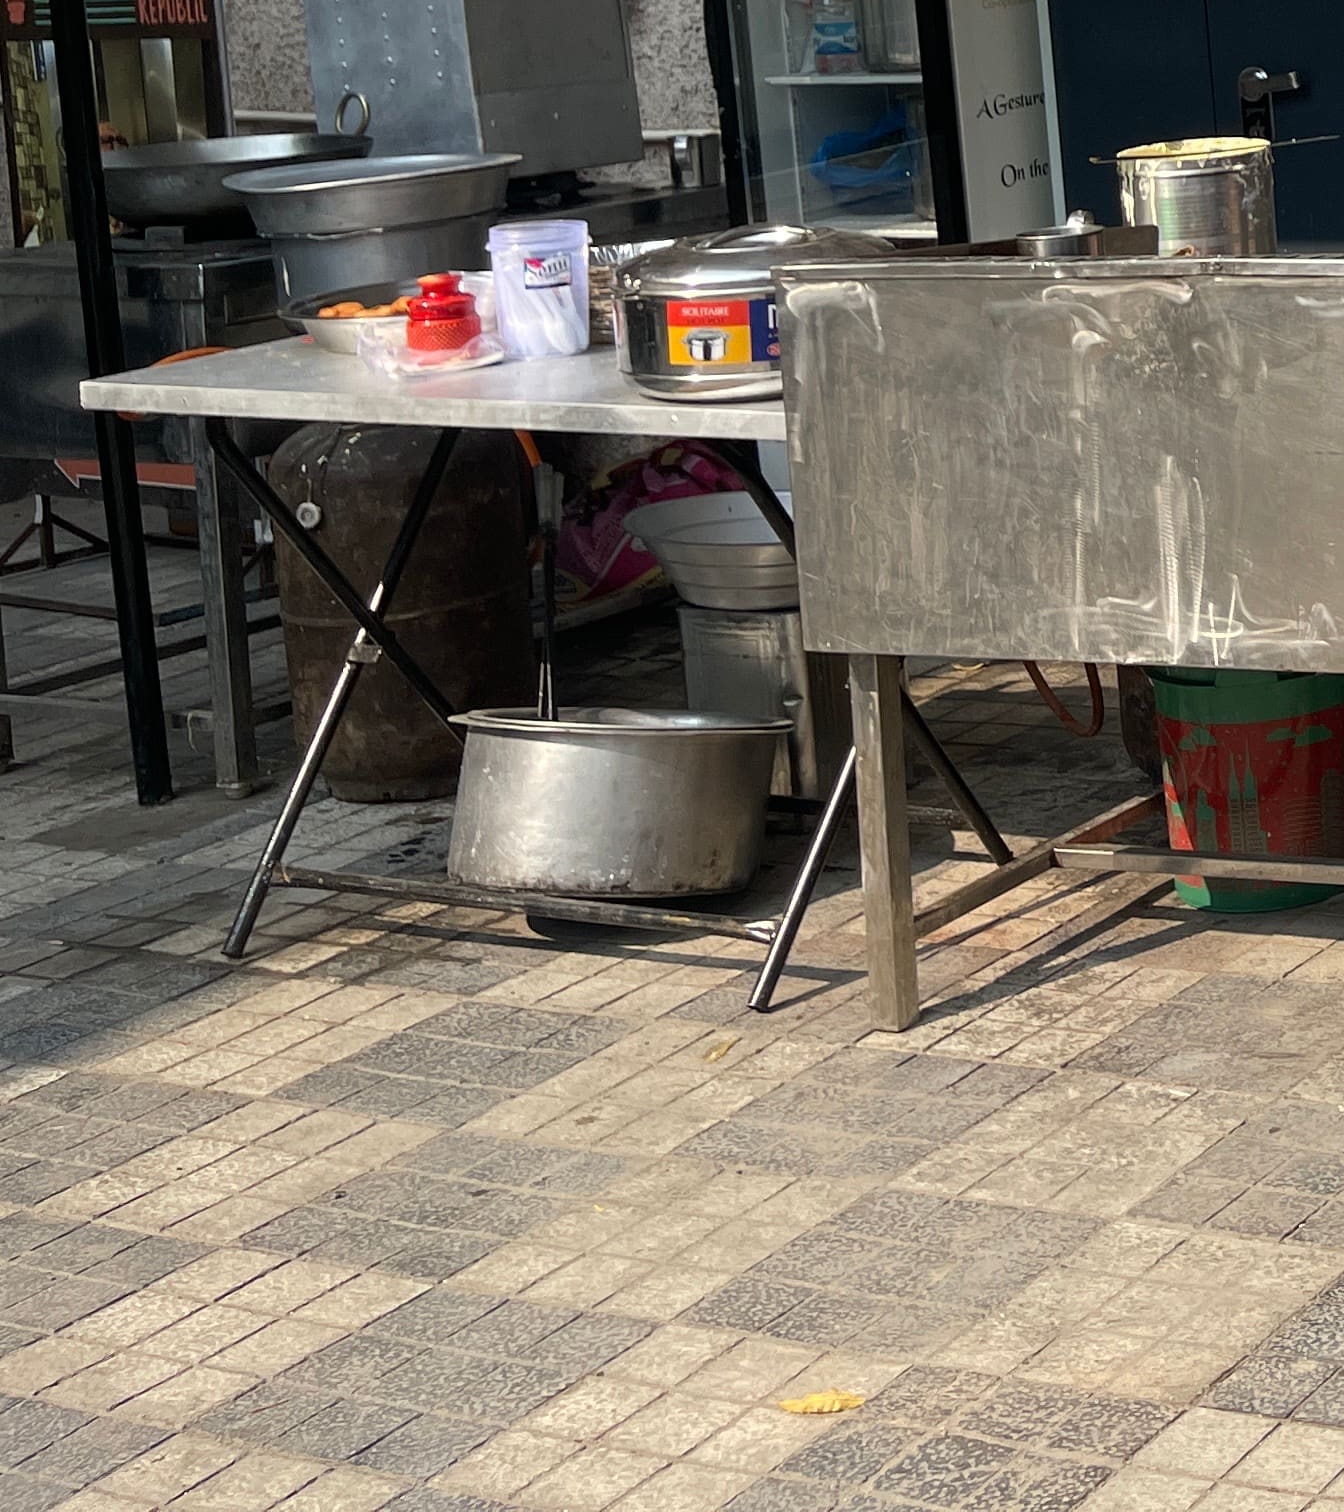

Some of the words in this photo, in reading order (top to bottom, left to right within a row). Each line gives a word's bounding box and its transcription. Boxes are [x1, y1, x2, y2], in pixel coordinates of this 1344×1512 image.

[976, 96, 994, 119] A
[993, 92, 1046, 117] Gesture
[1001, 163, 1026, 188] On
[1029, 157, 1049, 179] the
